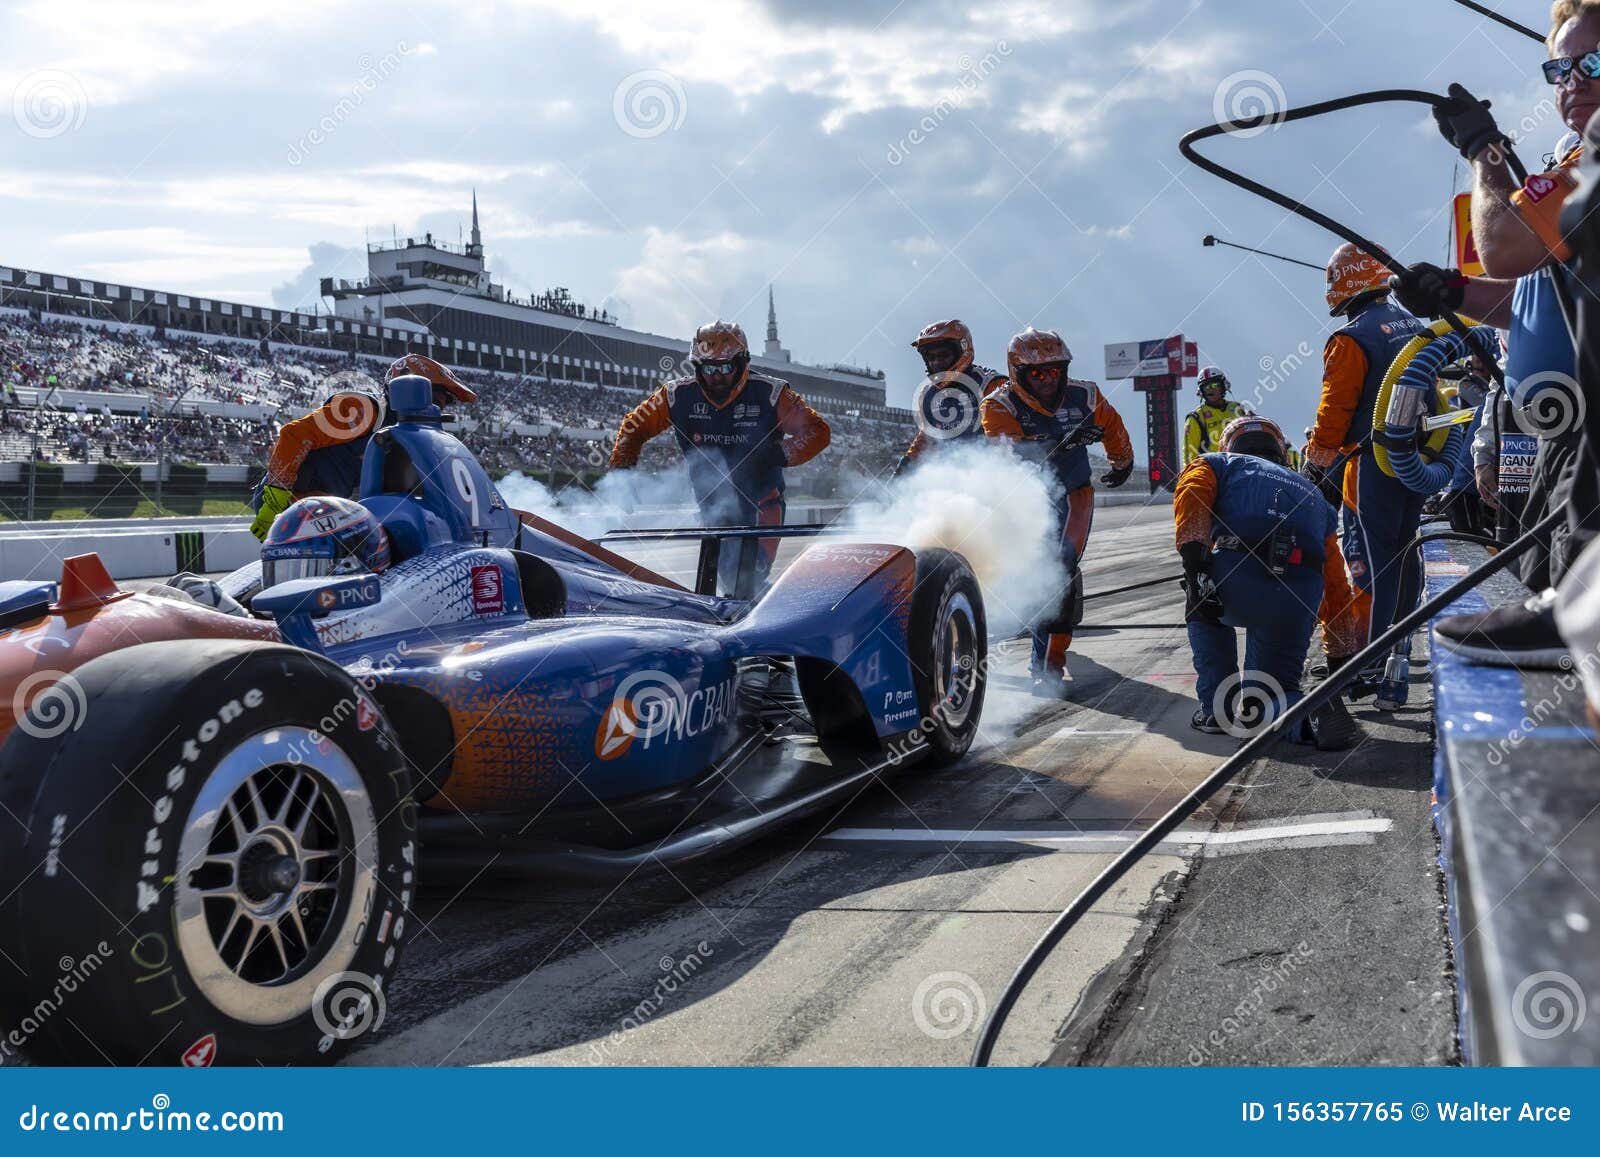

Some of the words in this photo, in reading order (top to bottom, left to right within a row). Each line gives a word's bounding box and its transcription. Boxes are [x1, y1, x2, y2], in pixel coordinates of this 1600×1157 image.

[1341, 259, 1370, 277] PNC
[452, 458, 480, 527] 9
[340, 585, 377, 605] PNC
[476, 601, 501, 610] Speedway
[884, 708, 918, 725] Firestone
[137, 688, 264, 912] Firestone
